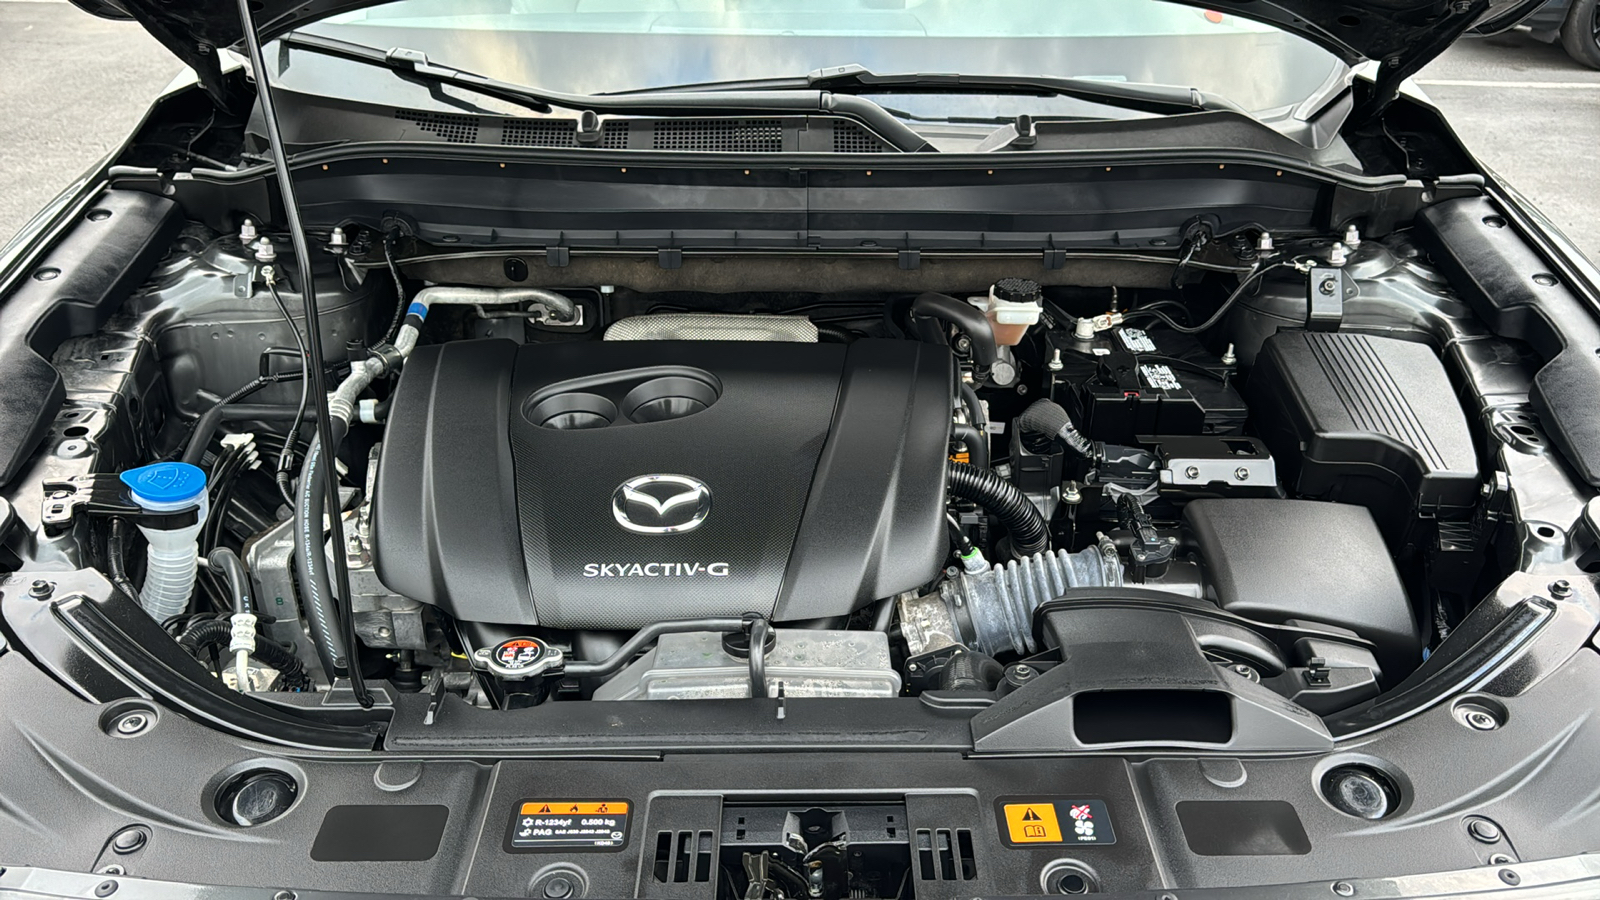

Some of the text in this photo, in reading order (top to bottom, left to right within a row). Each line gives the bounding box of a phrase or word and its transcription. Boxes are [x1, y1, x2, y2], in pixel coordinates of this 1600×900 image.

[583, 562, 729, 577] SKYACTIV-G
[535, 819, 572, 827] R-1234yf
[604, 819, 616, 827] kg
